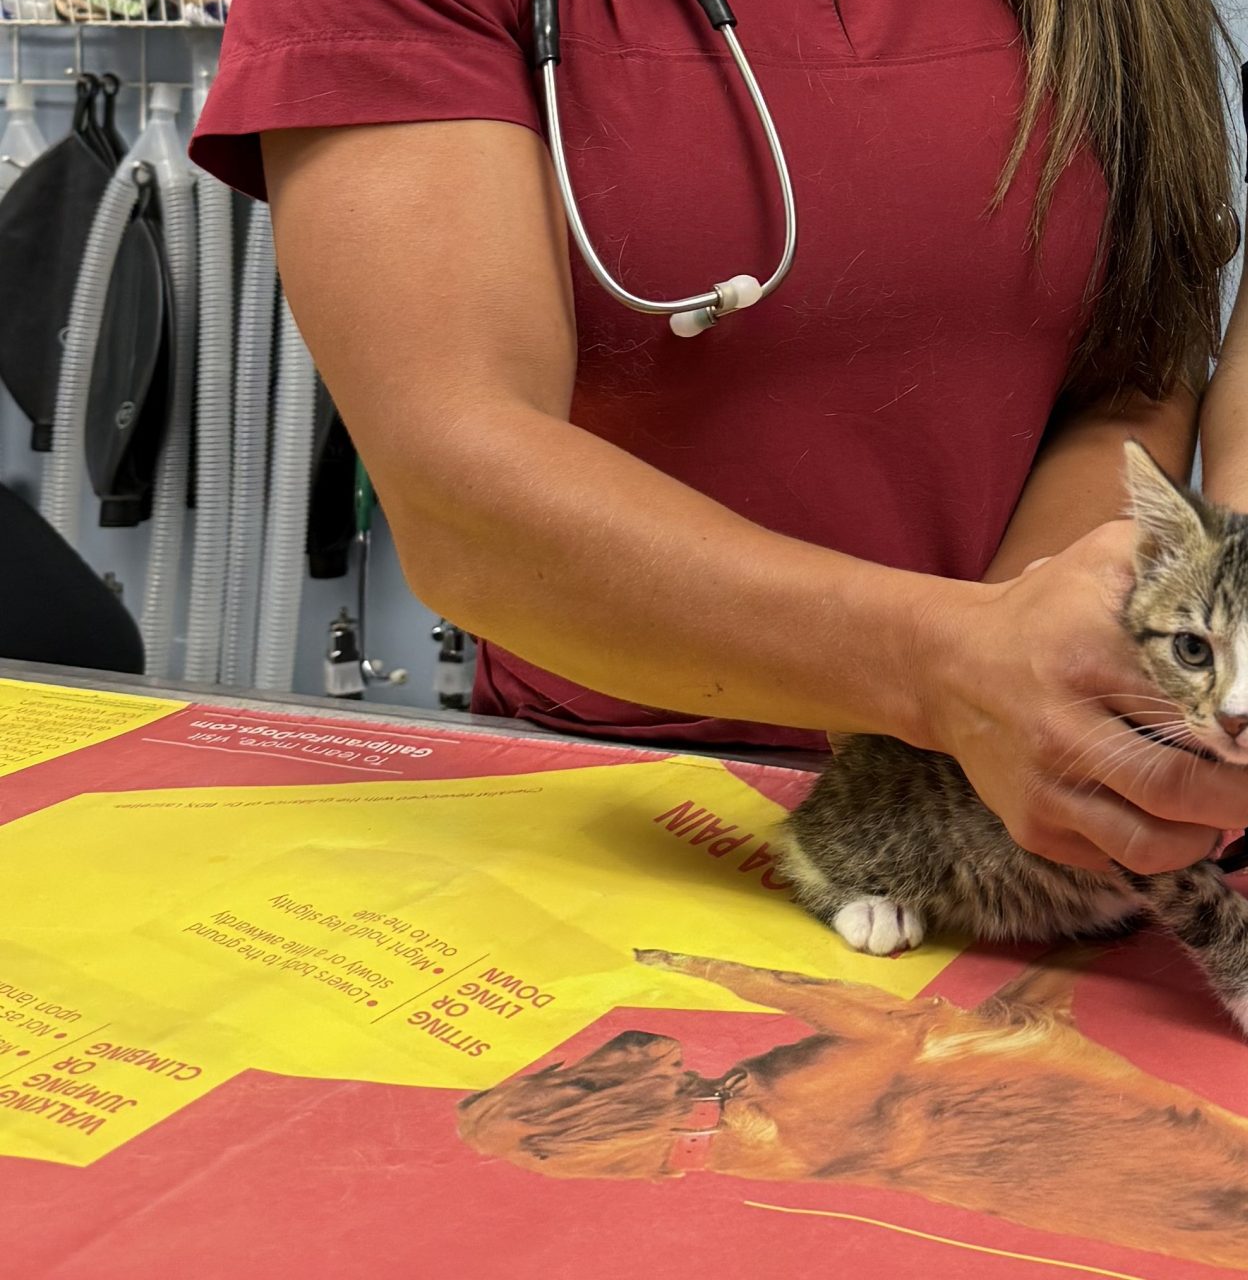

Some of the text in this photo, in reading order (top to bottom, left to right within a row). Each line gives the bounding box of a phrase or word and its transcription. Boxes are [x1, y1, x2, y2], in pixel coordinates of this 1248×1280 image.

[186, 732, 390, 767] To learn more, visit
[189, 720, 434, 759] GalliprantForDogs.com
[653, 799, 755, 858] PAIN
[268, 893, 324, 922] slightly
[318, 914, 346, 933] leg
[210, 910, 286, 946] awkwardly
[353, 910, 458, 957] out to the side
[353, 926, 394, 947] hold
[182, 922, 371, 1004] Lowers body to the ground
[283, 940, 318, 959] little
[325, 953, 346, 965] or
[386, 940, 438, 972] Might
[343, 960, 394, 991] slowly
[478, 967, 556, 1009] DOWN
[5, 1009, 25, 1023] as
[34, 1001, 83, 1023] upon
[431, 995, 470, 1018] OR
[457, 982, 524, 1020] LYING
[16, 1018, 58, 1038] Not
[407, 1010, 491, 1057] SITTING
[52, 1056, 97, 1075] OR
[84, 1042, 203, 1081] CLIMBING
[22, 1073, 138, 1114] JUMPING
